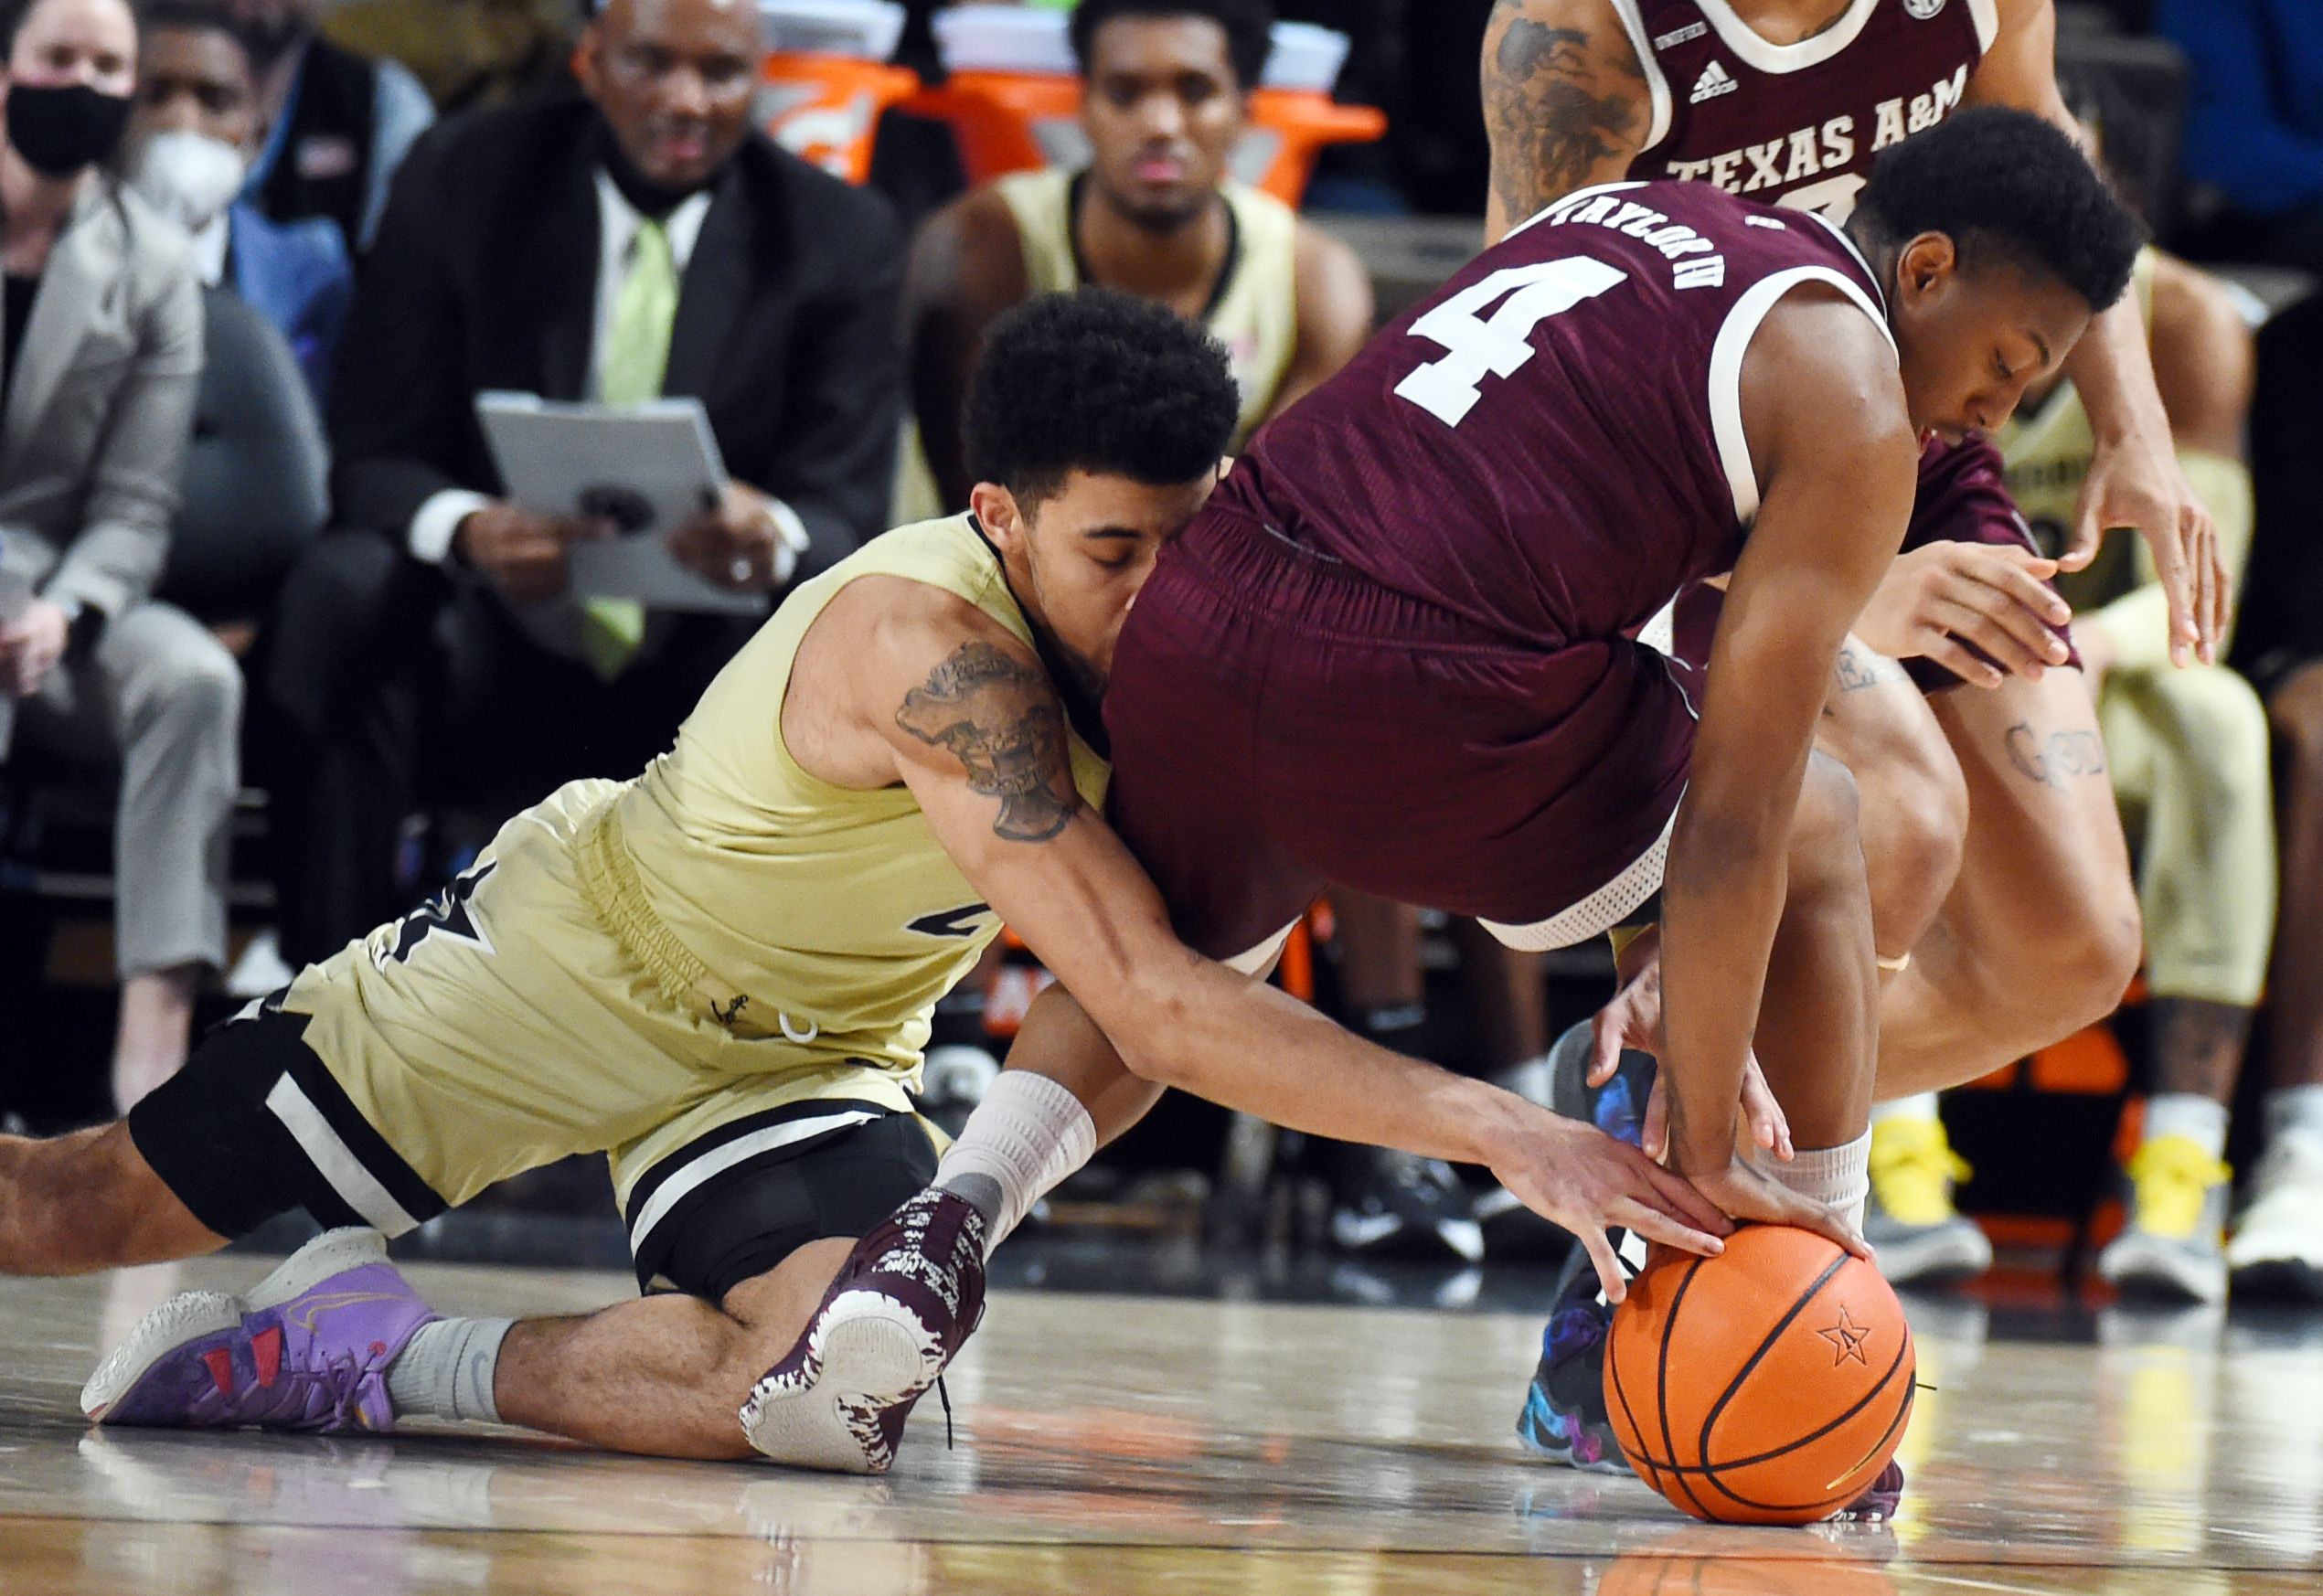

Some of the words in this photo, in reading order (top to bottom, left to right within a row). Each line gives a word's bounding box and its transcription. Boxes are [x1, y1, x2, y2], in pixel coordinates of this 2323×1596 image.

[1667, 115, 1855, 195] TEXAS
[1871, 63, 1968, 152] A&M
[1550, 195, 1714, 260] TAYLOR
[1393, 255, 1628, 428] 4
